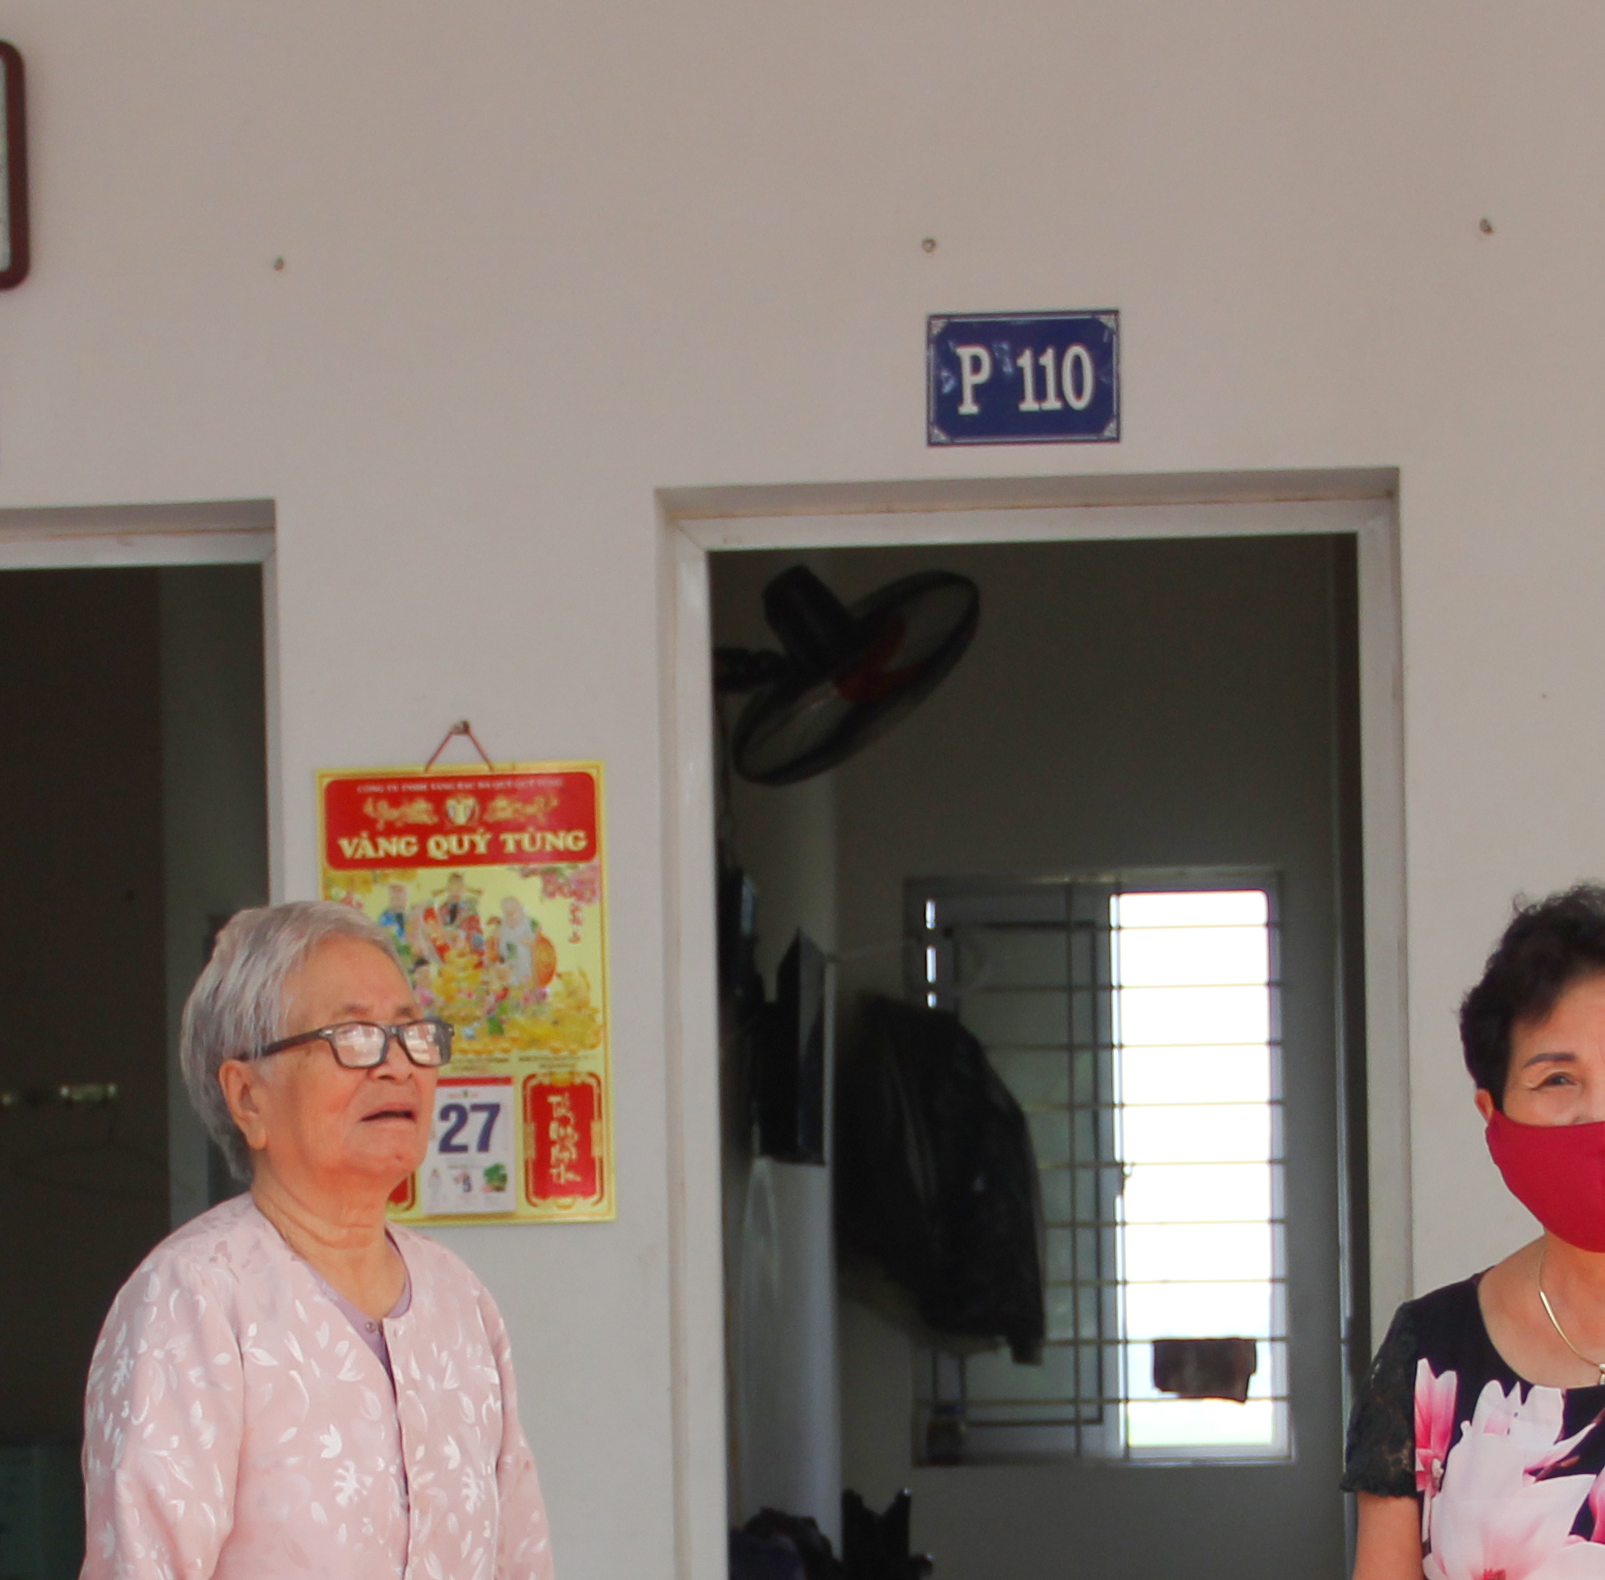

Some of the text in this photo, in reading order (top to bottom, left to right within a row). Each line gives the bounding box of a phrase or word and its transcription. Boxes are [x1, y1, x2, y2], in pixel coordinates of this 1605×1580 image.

[1016, 343, 1094, 412] 110
[338, 826, 589, 860] VÀNG QUÝ TÙNG
[438, 1103, 501, 1153] 27
